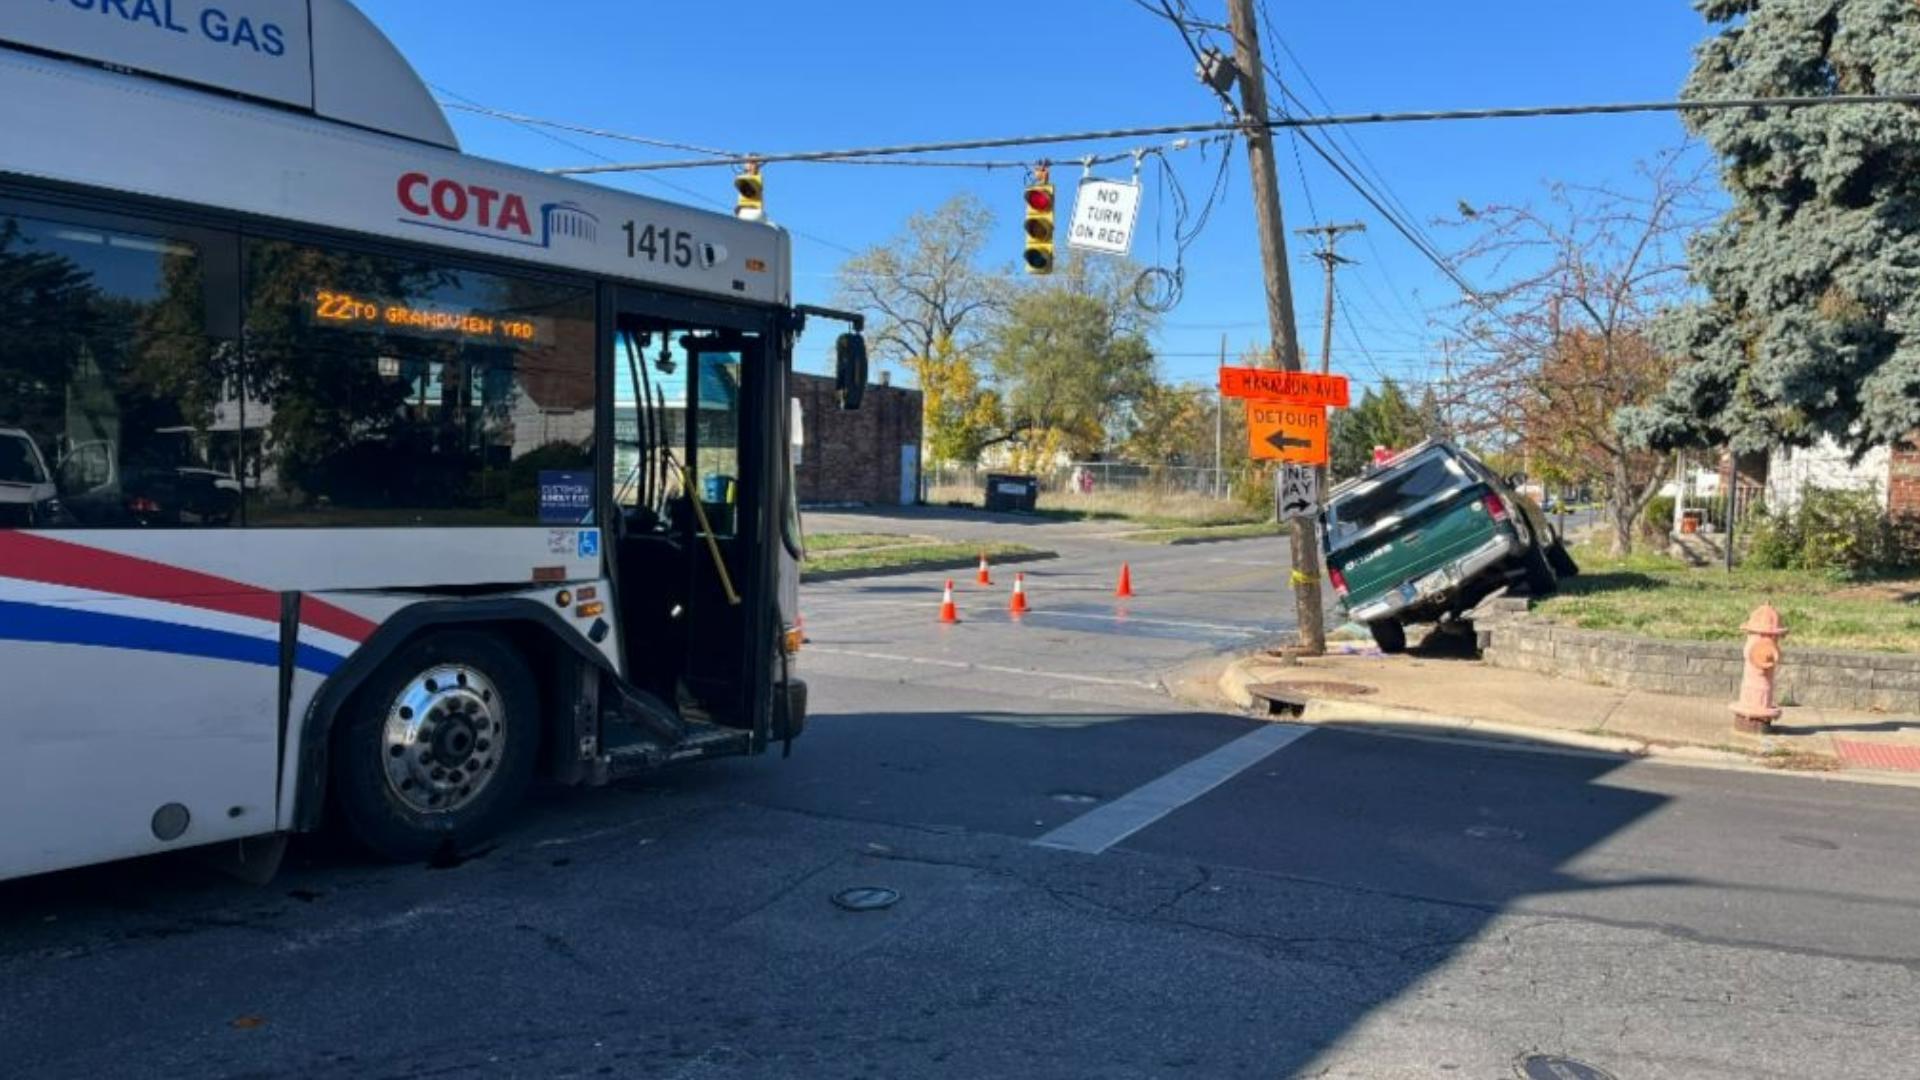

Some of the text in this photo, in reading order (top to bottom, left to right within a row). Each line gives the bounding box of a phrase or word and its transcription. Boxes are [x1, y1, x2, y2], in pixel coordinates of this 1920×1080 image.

[200, 8, 285, 56] GAS
[397, 172, 532, 235] COTA
[1097, 188, 1119, 204] NO
[1088, 206, 1122, 225] TURN
[621, 220, 692, 268] 1415
[1075, 223, 1124, 244] ON RED
[316, 290, 536, 340] 22 TO GRANDVIEW YRD
[1316, 381, 1341, 400] AVE
[1254, 408, 1318, 429] DETOUR
[1285, 467, 1312, 479] NE
